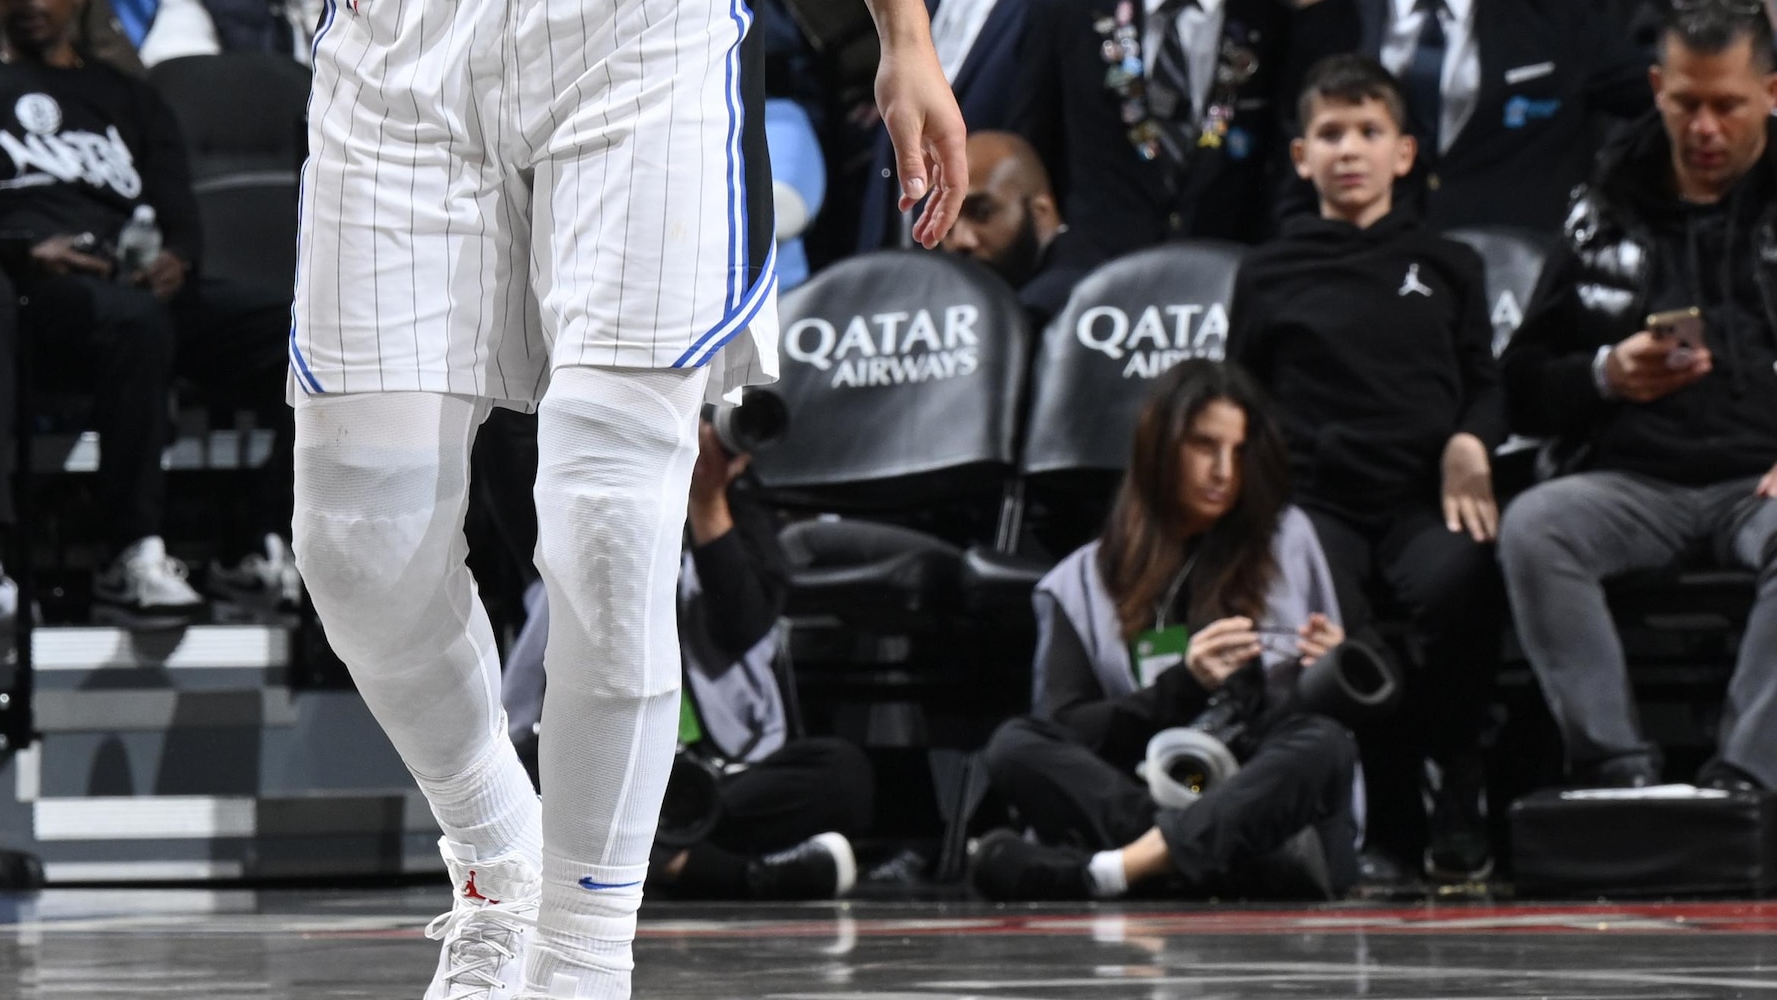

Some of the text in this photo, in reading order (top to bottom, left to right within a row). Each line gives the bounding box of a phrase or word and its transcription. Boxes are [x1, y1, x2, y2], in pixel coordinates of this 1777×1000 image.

[784, 304, 980, 371] QATAR
[1076, 302, 1230, 359] QATA
[830, 346, 979, 389] AIRWAYS
